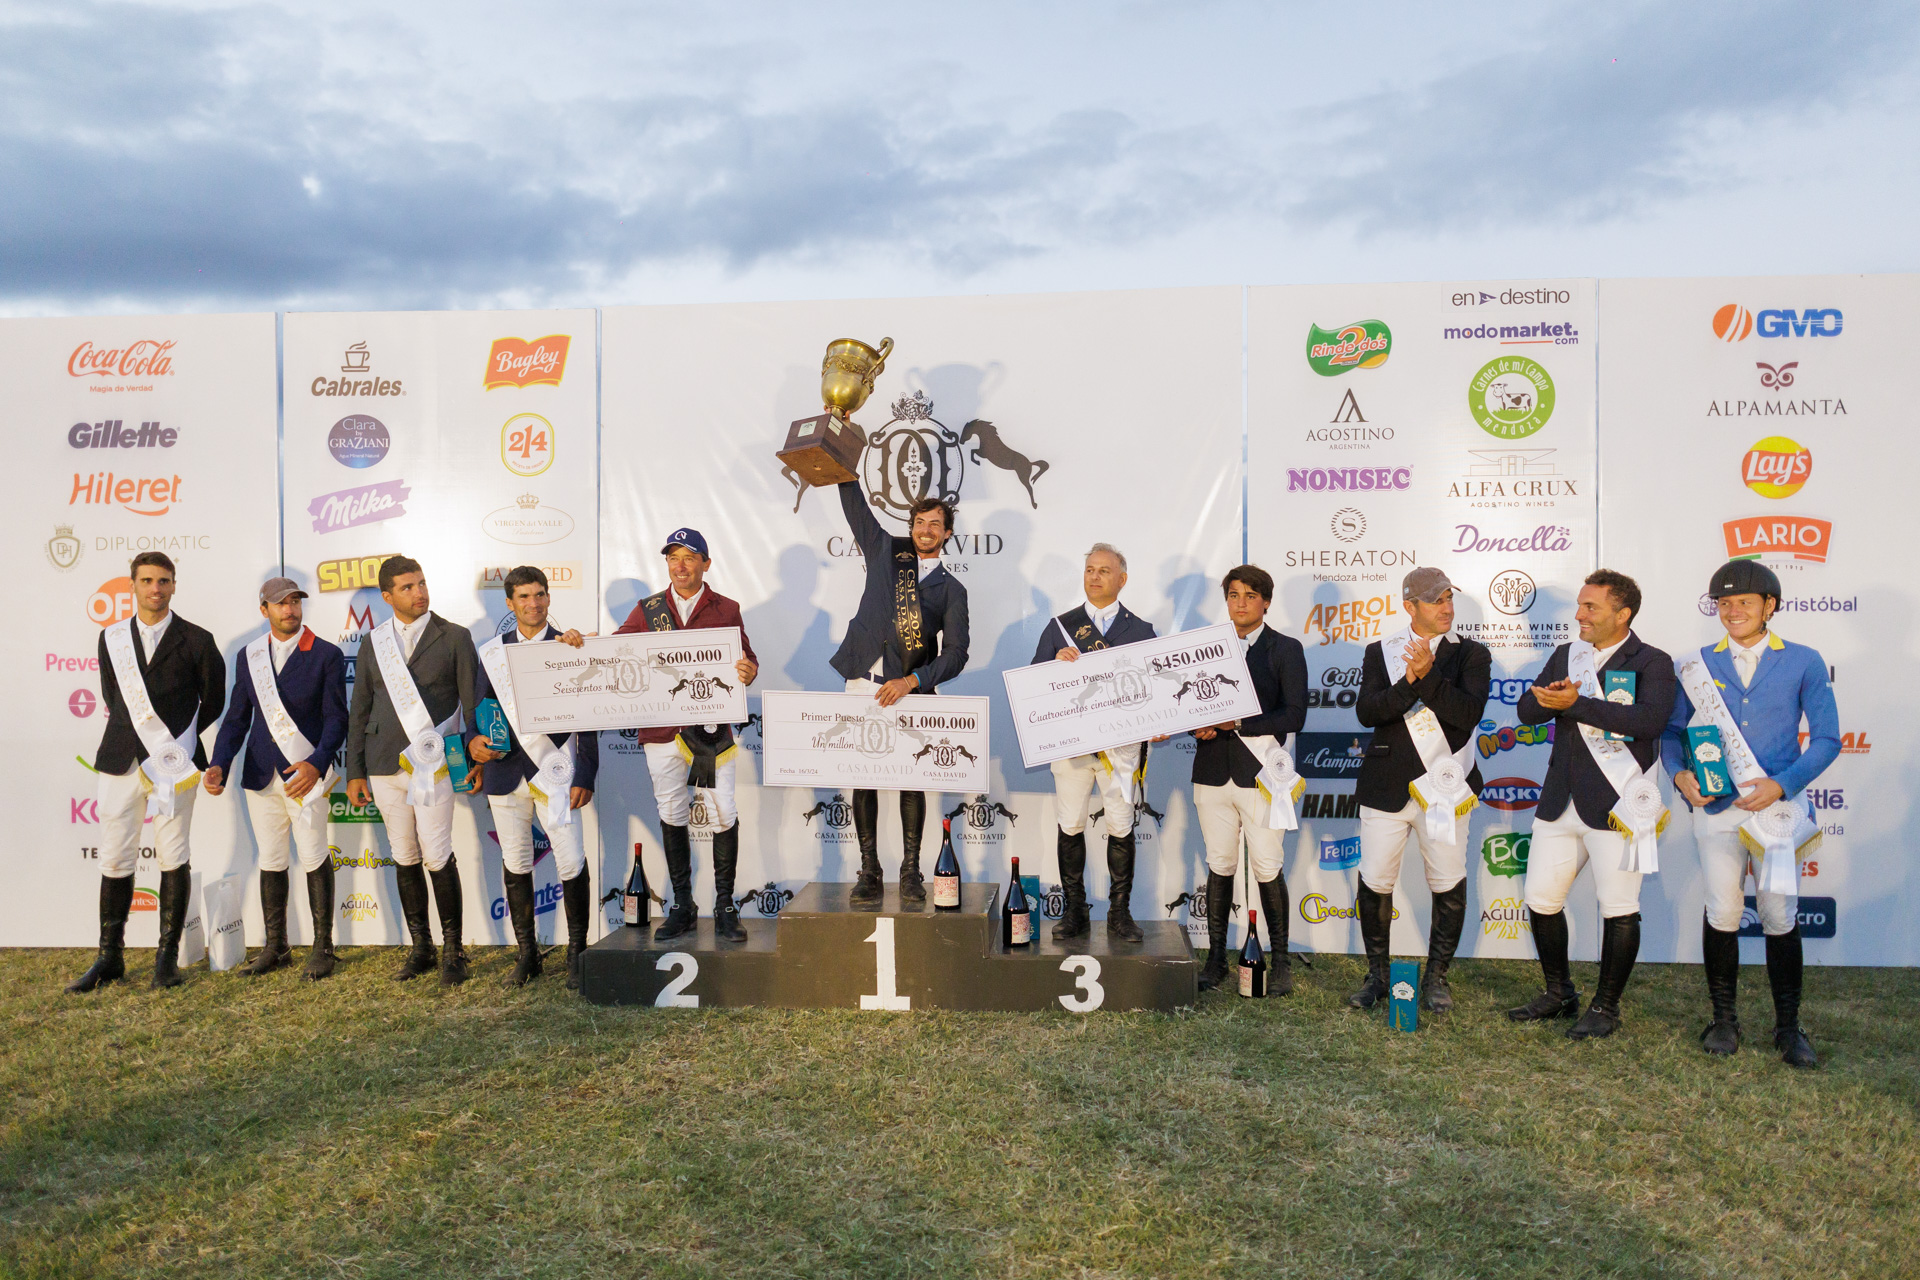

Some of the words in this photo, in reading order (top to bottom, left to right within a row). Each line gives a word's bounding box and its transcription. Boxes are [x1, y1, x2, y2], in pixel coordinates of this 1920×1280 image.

[1451, 293, 1475, 306] en
[1500, 288, 1570, 305] destino
[1756, 308, 1843, 338] GMO
[1311, 340, 1354, 358] Rinde
[1359, 337, 1388, 352] dos
[1555, 337, 1579, 345] com
[67, 339, 178, 378] Coca-Cola
[495, 345, 561, 377] Bagley
[1472, 365, 1498, 392] Carnes
[1498, 359, 1510, 373] de
[1511, 360, 1526, 373] mi
[1525, 363, 1549, 392] Campo
[90, 385, 114, 394] Magia
[311, 376, 402, 397] Cabrales
[1706, 398, 1848, 417] ALPAMANTA
[342, 418, 376, 431] Clara
[1482, 416, 1541, 436] mendoza
[67, 420, 178, 449] Gillette
[329, 437, 390, 450] GRAZIANI
[1306, 427, 1395, 442] AGOSTINO
[1746, 451, 1808, 486] Lay's
[68, 472, 182, 505] Hileret
[1287, 467, 1412, 492] NONISEC
[1447, 481, 1504, 498] ALFA
[1513, 480, 1579, 497] CRUX
[320, 488, 397, 528] Milka
[95, 535, 211, 551] DIPLOMATIC
[826, 536, 865, 557] CA
[939, 533, 1003, 556] VID
[1451, 524, 1573, 553] Doncella
[1734, 523, 1822, 549] LARIO
[946, 563, 969, 573] SES
[1285, 550, 1416, 567] SHERATON
[319, 557, 393, 591] SHO
[484, 567, 502, 582] LA
[1313, 573, 1357, 582] Mendoza
[1361, 572, 1388, 582] Hotel
[1303, 594, 1397, 635] APEROL
[900, 605, 912, 651] DAVID
[909, 610, 924, 650] 2024
[1457, 624, 1523, 632] HUENTALA
[1529, 623, 1569, 631] WINES
[45, 653, 99, 671] Preve
[544, 657, 587, 671] Segundo
[589, 655, 621, 666] Puesto
[657, 648, 722, 666] $600.000
[1151, 644, 1224, 673] $450.000
[552, 681, 603, 696] Seiscientos
[605, 677, 620, 692] mil
[1048, 679, 1080, 692] Tercer
[1082, 670, 1114, 687] Puesto
[1321, 667, 1364, 687] Cofl
[701, 703, 725, 711] DAVID
[1028, 702, 1089, 724] Cuatrocientos
[1090, 694, 1131, 711] cincuenta
[1133, 686, 1148, 701] mil
[1188, 704, 1209, 715] CASA
[1210, 699, 1235, 711] DAVID
[1306, 688, 1358, 709] BLO
[554, 713, 575, 721] 16/3/24
[592, 704, 628, 716] CASA
[630, 701, 671, 714] DAVID
[801, 711, 833, 722] Primer
[834, 713, 865, 723] Puesto
[898, 714, 976, 730] $1.000.000
[811, 736, 826, 749] Un
[828, 737, 855, 750] millón
[1038, 741, 1056, 751] Fecha
[1058, 736, 1081, 747] 16/3/24
[1726, 729, 1752, 770] 2024
[837, 763, 869, 773] CASA
[873, 764, 914, 775] DAVID
[1313, 747, 1363, 774] Campa
[943, 771, 967, 779] DAVID
[1479, 786, 1543, 803] MISKY
[1324, 838, 1362, 860] Felpi
[340, 900, 378, 910] AGUILA
[490, 882, 564, 921] Ginte
[608, 917, 624, 925] CAS
[1480, 908, 1529, 921] AGUIL
[1798, 911, 1826, 926] cro
[860, 917, 911, 1011] 1
[654, 952, 699, 1008] 2
[1058, 954, 1105, 1013] 3
